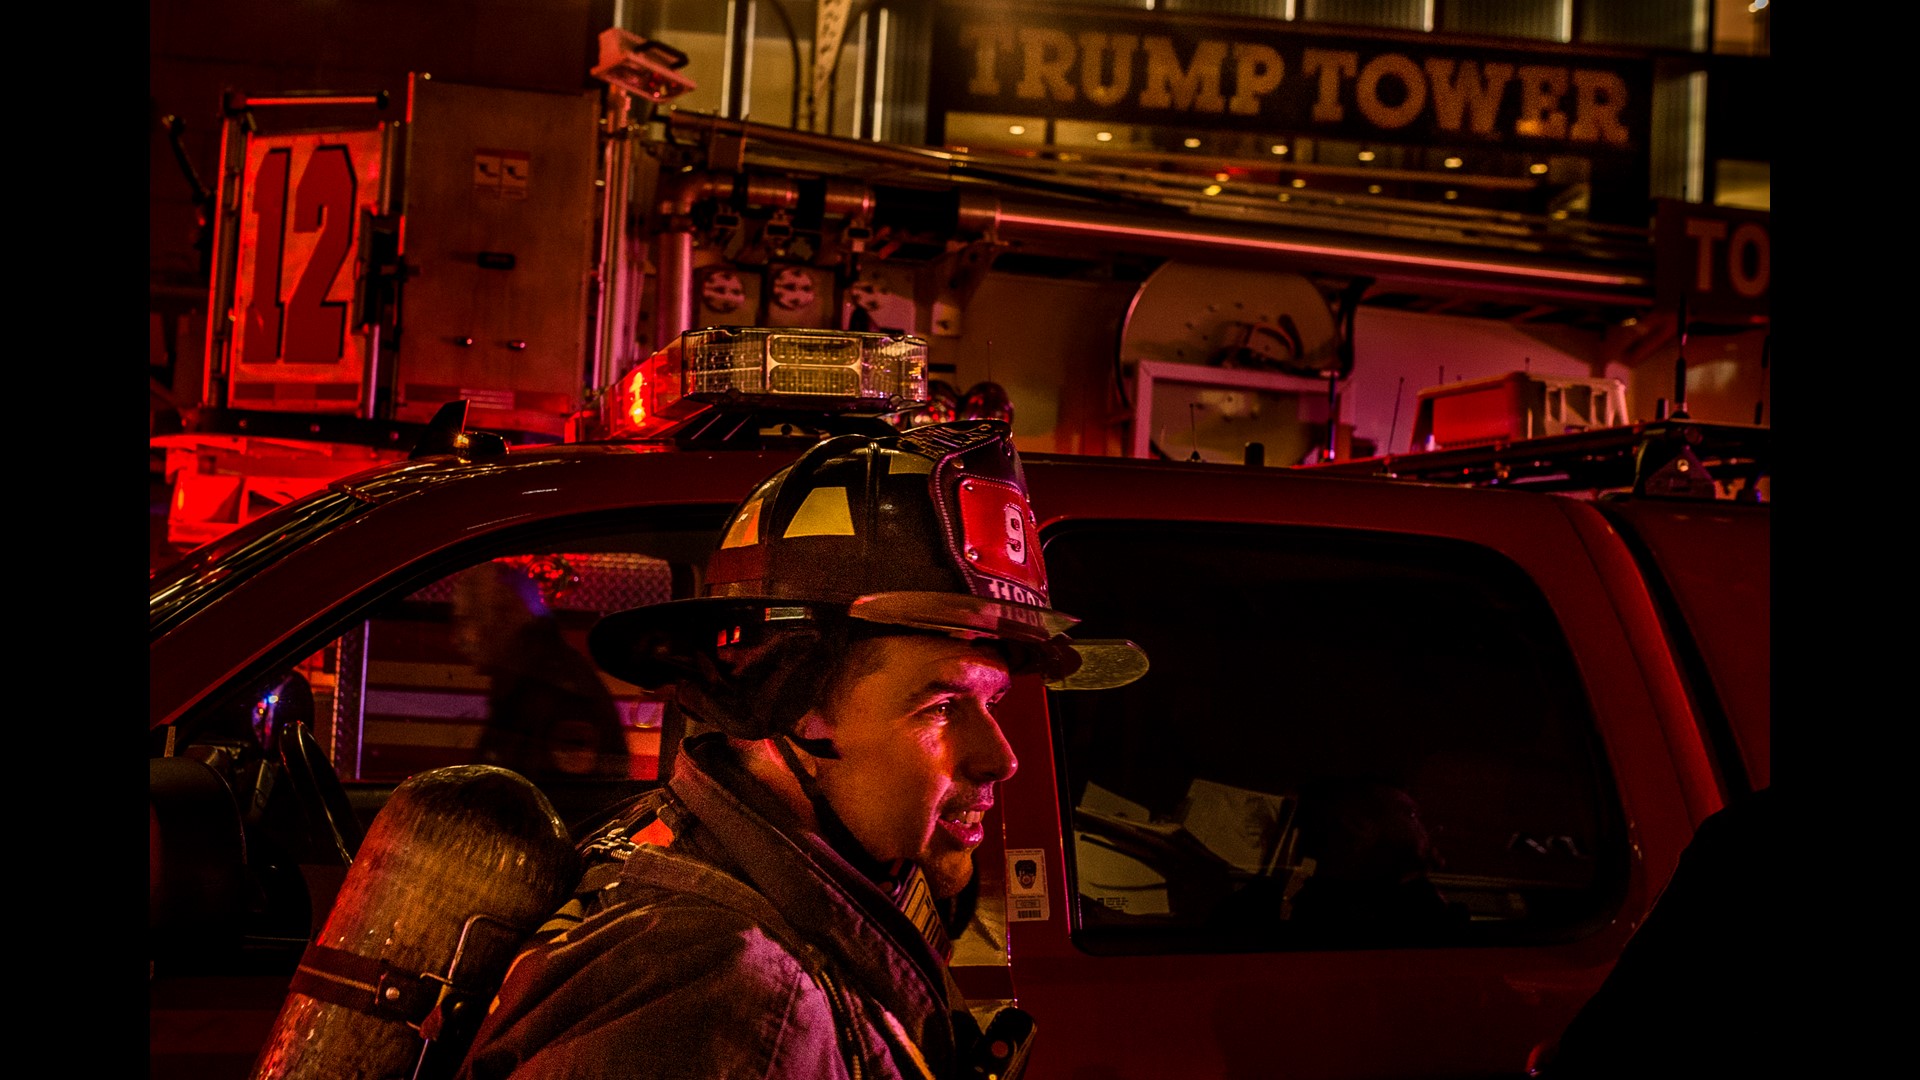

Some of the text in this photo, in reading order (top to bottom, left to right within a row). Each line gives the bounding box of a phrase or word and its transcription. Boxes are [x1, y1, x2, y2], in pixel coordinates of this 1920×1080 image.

[967, 26, 1629, 146] TRUMP TOWER
[243, 145, 357, 363] 12
[1686, 217, 1770, 296] TO
[1004, 502, 1026, 564] 9
